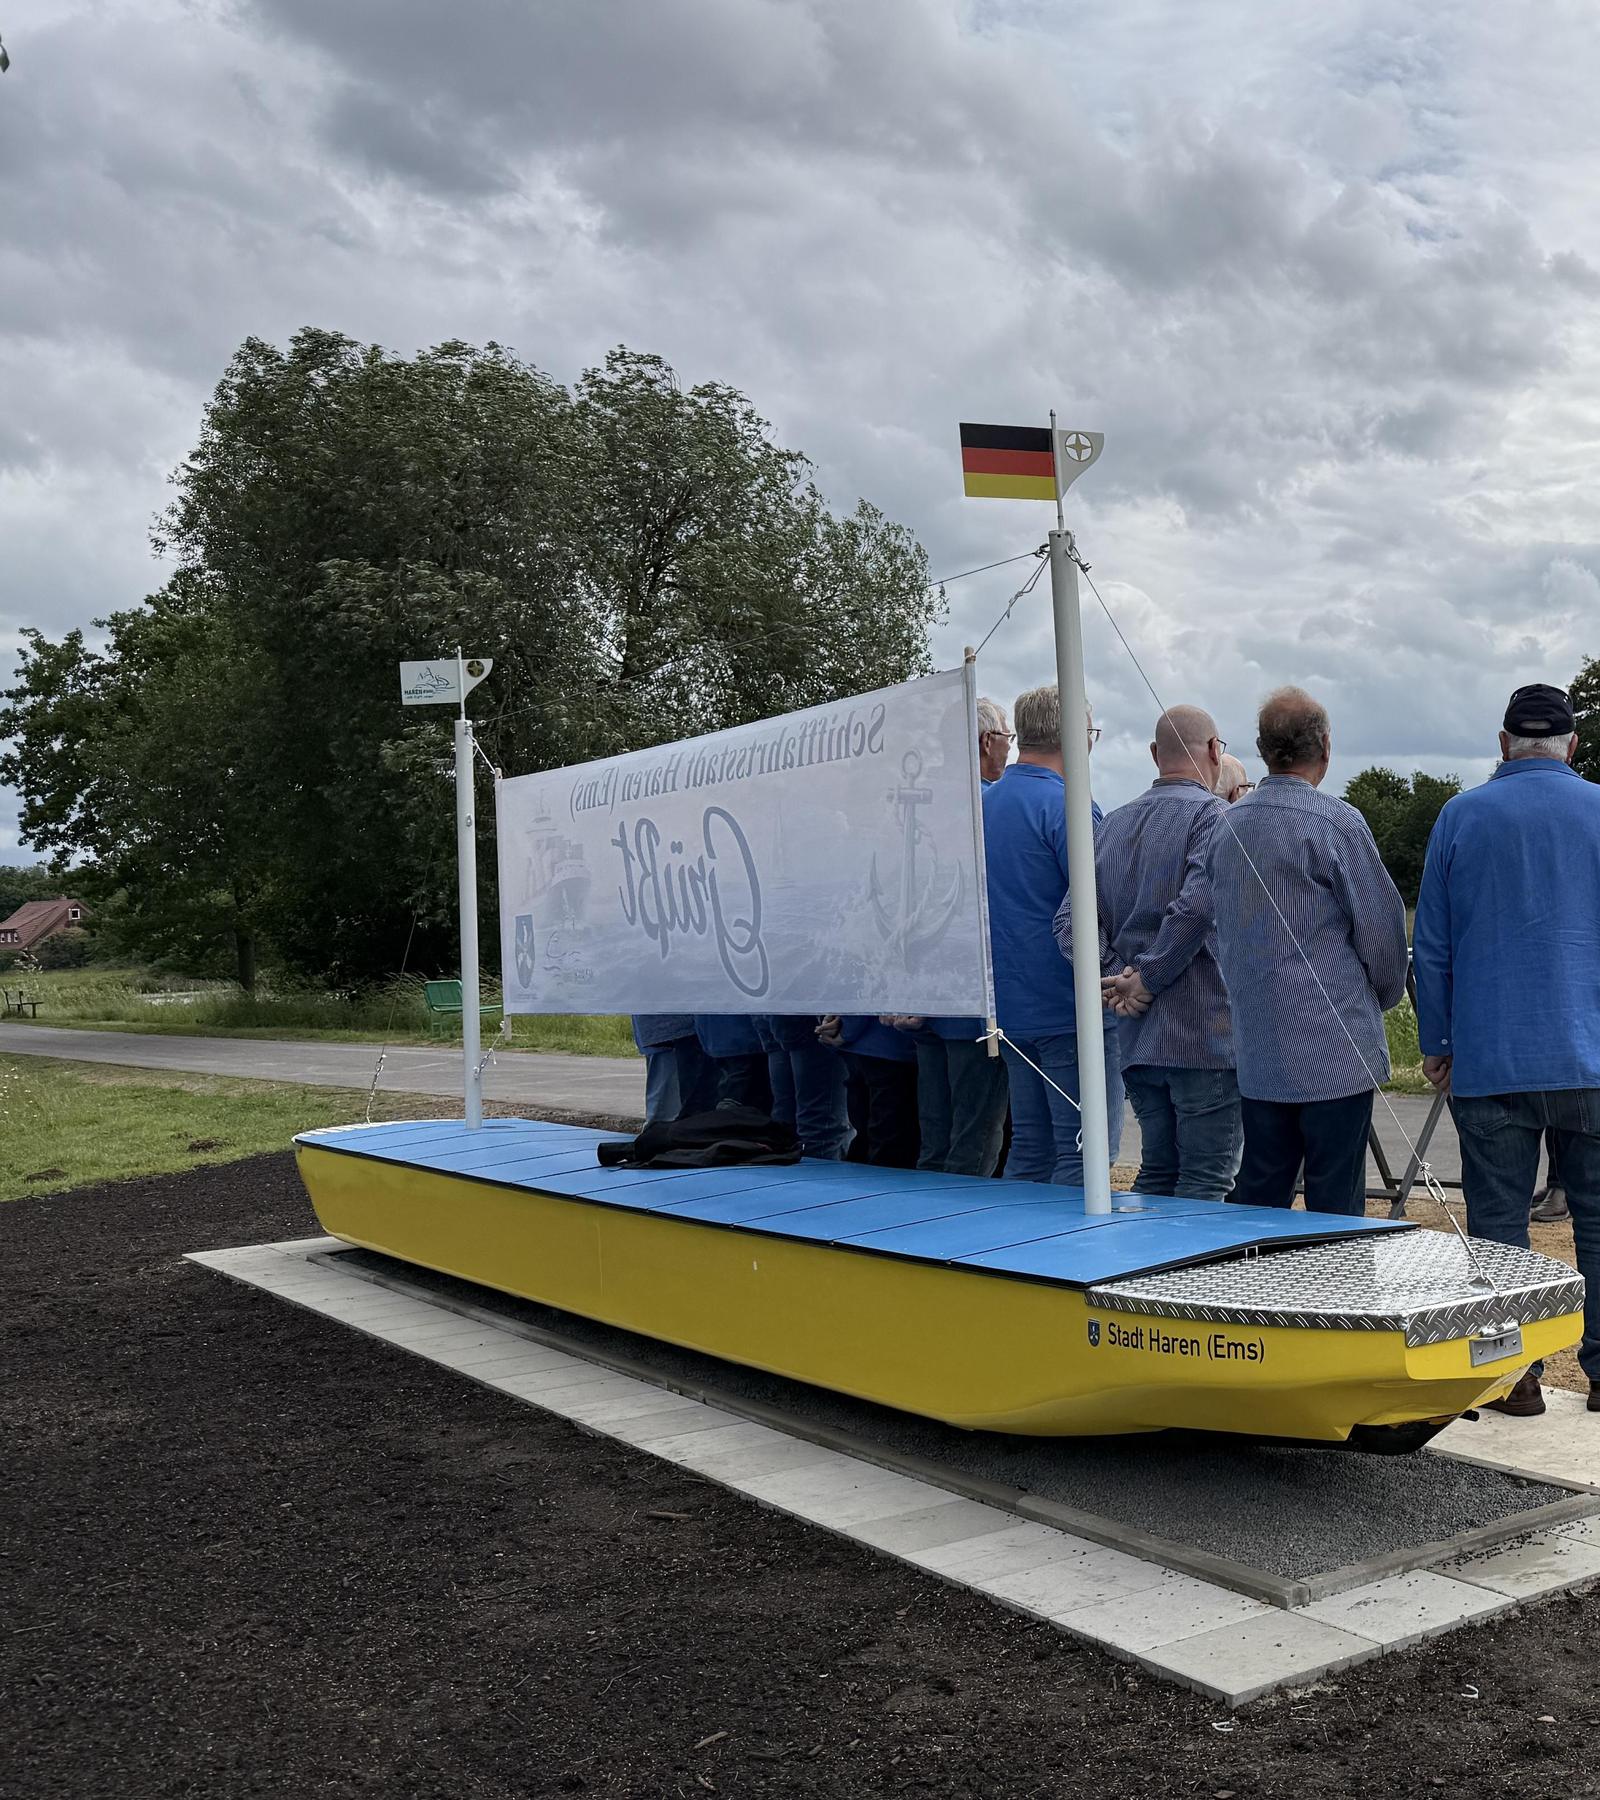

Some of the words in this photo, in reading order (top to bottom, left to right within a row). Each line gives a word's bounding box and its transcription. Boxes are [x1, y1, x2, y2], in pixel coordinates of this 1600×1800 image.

[1108, 1322, 1144, 1350] Stadt
[1149, 1328, 1200, 1357] Haren
[1207, 1334, 1265, 1364] (Ems)
